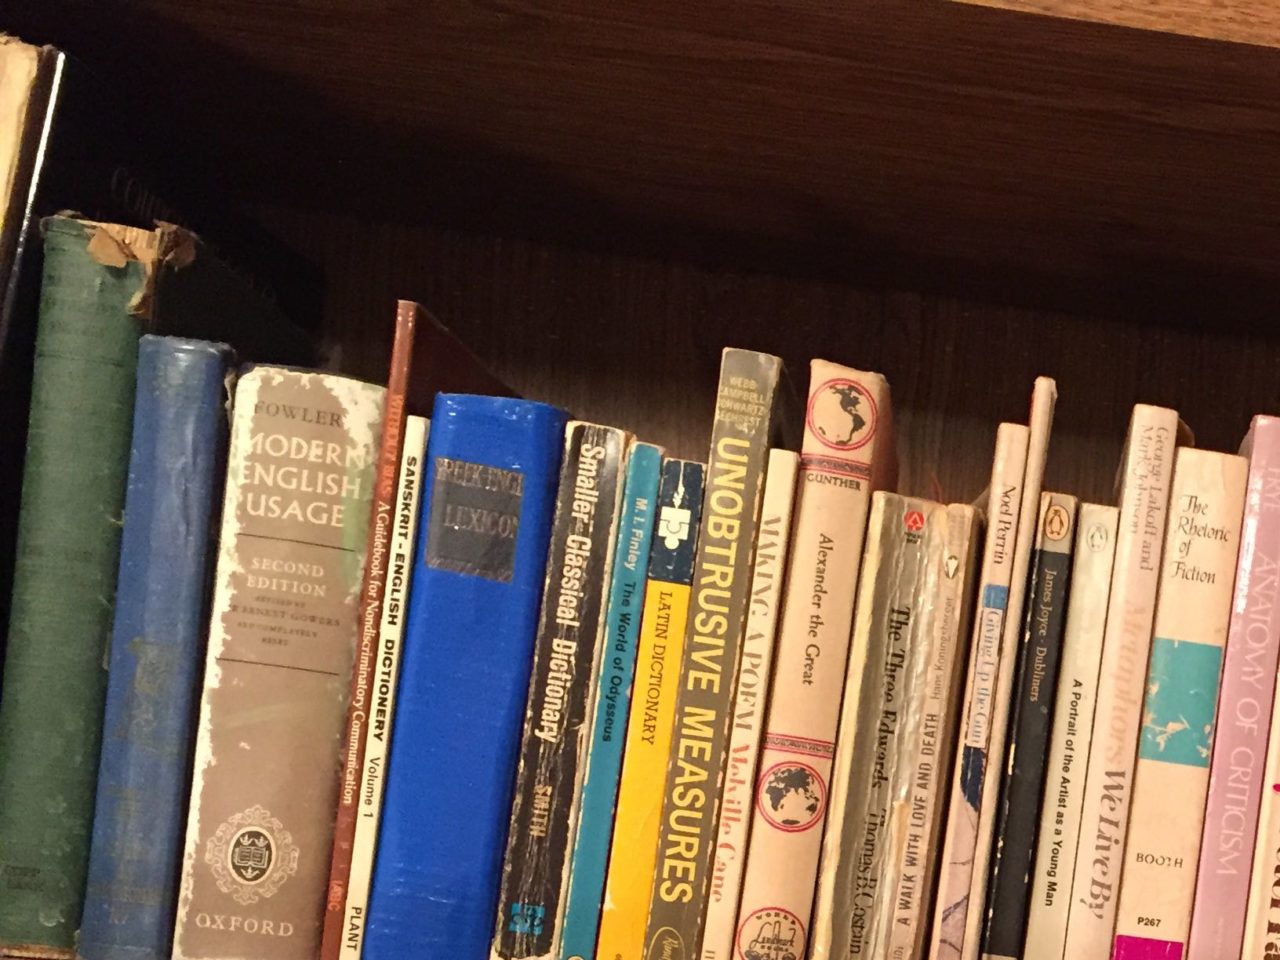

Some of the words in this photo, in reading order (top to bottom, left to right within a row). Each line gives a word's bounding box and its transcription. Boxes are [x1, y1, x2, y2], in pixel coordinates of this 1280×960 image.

[398, 455, 417, 539] SANSKRIT
[571, 442, 606, 520] Smaller
[807, 473, 862, 492] GUNTHER
[246, 492, 345, 528] USAGE
[251, 557, 324, 577] SECOND
[367, 512, 388, 577] Guidebook
[626, 528, 644, 571] Finley
[688, 437, 750, 694] UNOBTRUSIVE
[247, 576, 326, 597] EDITION
[387, 552, 405, 627] ENGLISH
[556, 534, 592, 627] Classical
[813, 532, 834, 608] Alexander
[1170, 560, 1216, 586] Fiction
[613, 612, 631, 652] World
[653, 591, 672, 641] LATIN
[1238, 552, 1279, 692] ANATOMY
[802, 642, 821, 686] Great
[1030, 646, 1048, 703] Dubliners
[534, 638, 577, 744] Dictionary
[602, 674, 622, 743] Odysseus
[641, 644, 667, 745] DICTIONARY
[343, 709, 365, 804] Communication
[926, 713, 939, 756] DEATH
[364, 757, 381, 806] Volume
[660, 707, 716, 903] MEASURES
[912, 792, 928, 831] LOVE
[1215, 747, 1254, 876] CRITICISM
[905, 832, 921, 868] WITH
[1046, 840, 1064, 879] Young
[898, 871, 915, 912] WALK
[195, 912, 293, 937] OXFORD
[346, 906, 362, 951] PLANT
[1137, 916, 1162, 929] P267
